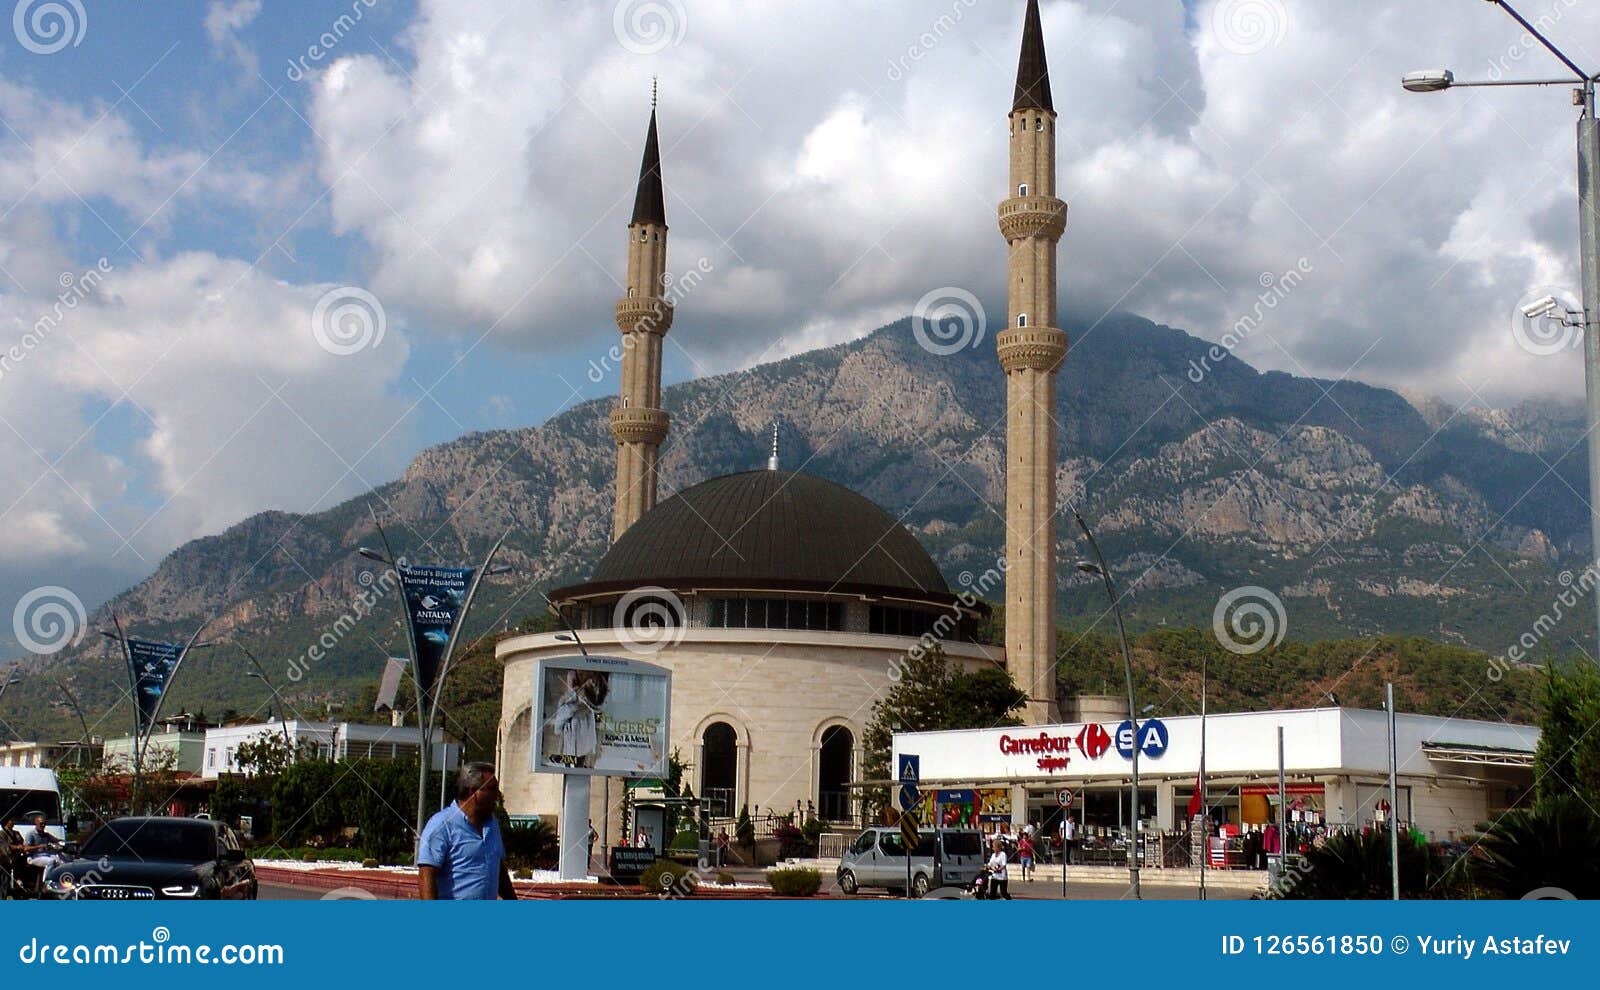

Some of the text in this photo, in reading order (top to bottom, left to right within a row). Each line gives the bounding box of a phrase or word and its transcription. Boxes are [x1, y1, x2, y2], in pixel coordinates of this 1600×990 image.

[435, 570, 463, 579] Biggest
[404, 576, 465, 587] Tunnel Aquarium
[416, 610, 451, 619] ANTALYA
[1000, 732, 1071, 755] Carrefour
[1037, 755, 1070, 773] süper
[1060, 793, 1072, 803] 50
